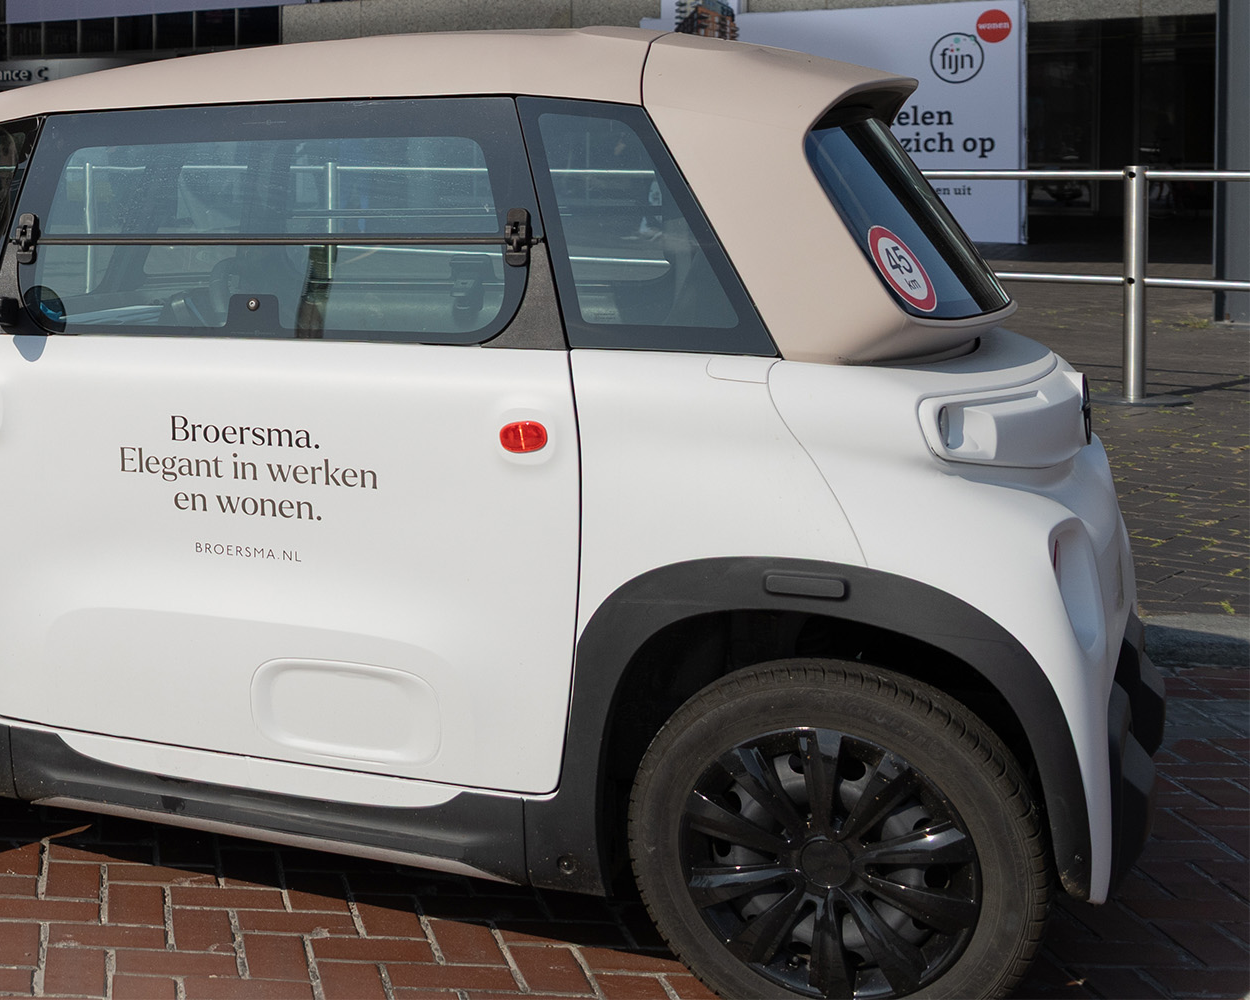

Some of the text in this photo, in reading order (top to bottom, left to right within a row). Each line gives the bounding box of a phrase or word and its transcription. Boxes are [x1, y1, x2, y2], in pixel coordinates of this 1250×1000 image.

[37, 67, 49, 81] C
[940, 48, 974, 75] fijn
[892, 106, 954, 126] elen
[901, 132, 996, 158] zich op
[954, 185, 972, 196] uit
[885, 246, 914, 274] 45
[904, 279, 921, 290] km
[171, 415, 320, 449] Broersma.
[120, 447, 378, 490] Elegant in werken
[174, 491, 322, 521] en wonen.
[195, 542, 302, 563] BROERSMA.NL
